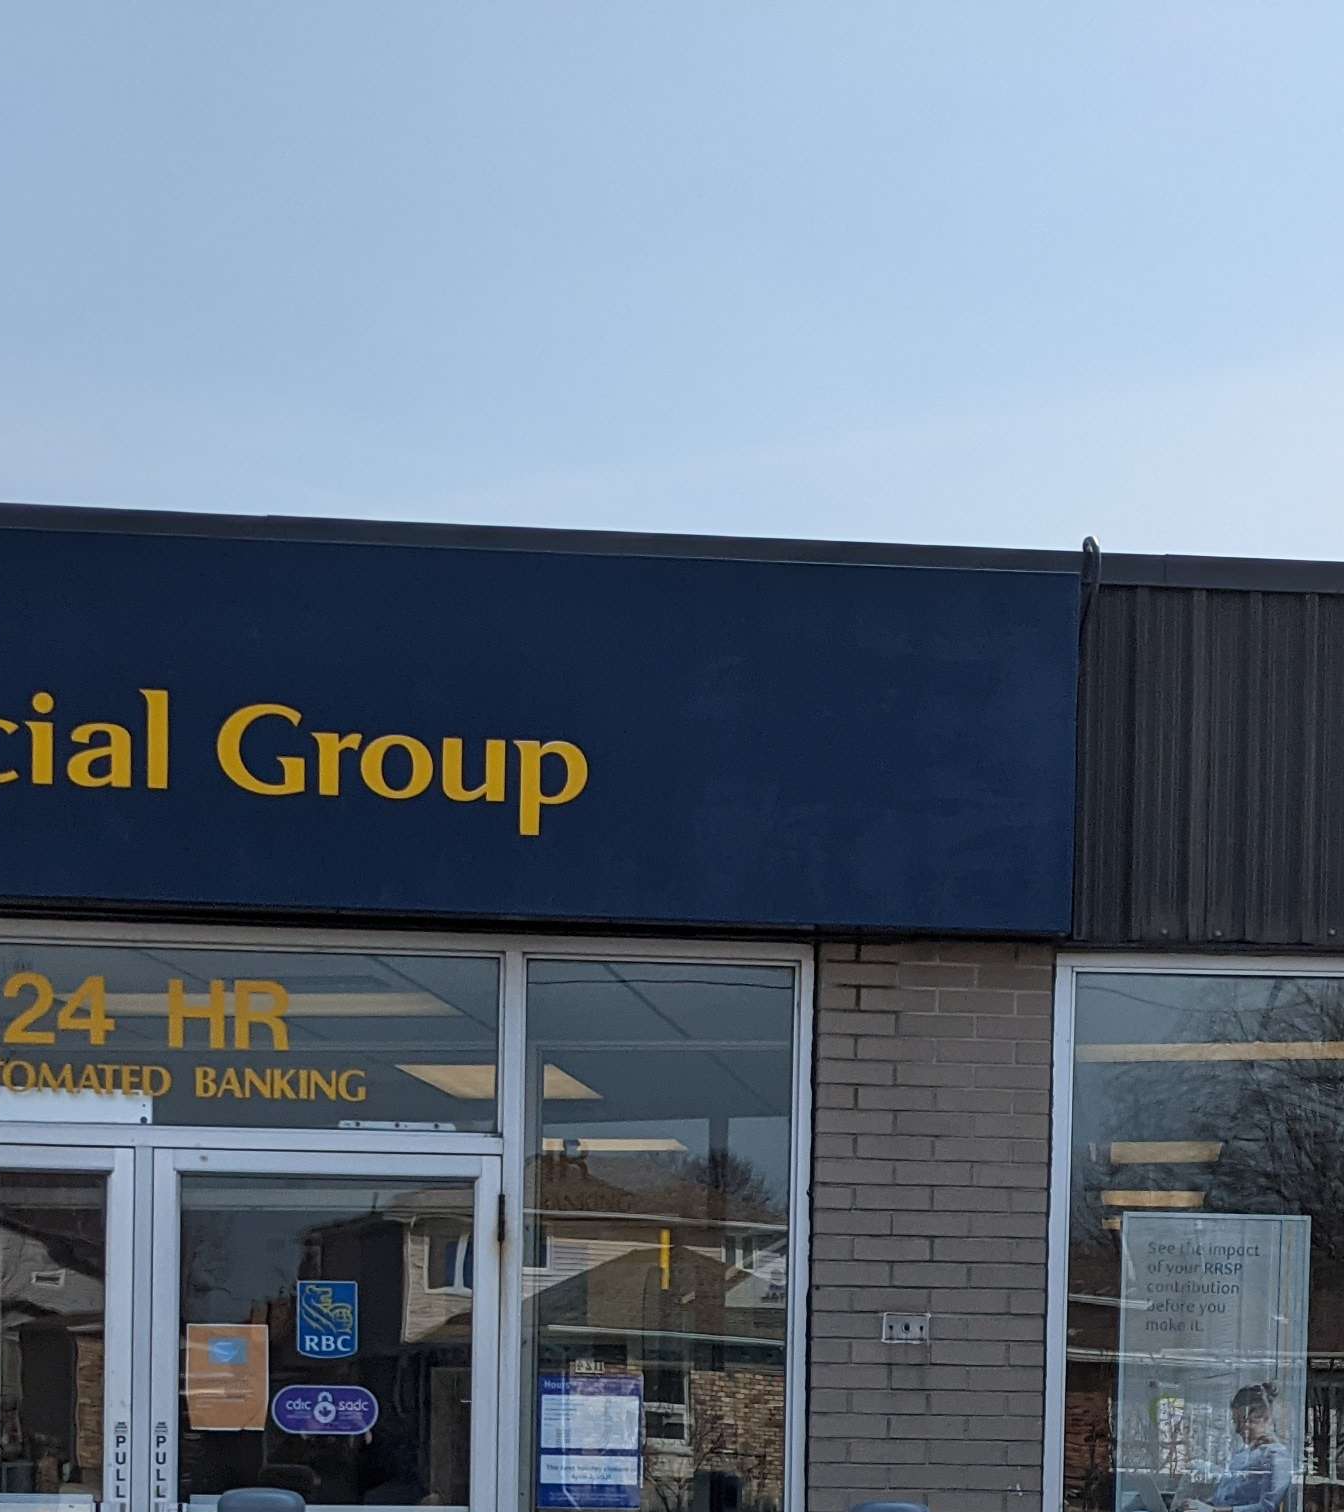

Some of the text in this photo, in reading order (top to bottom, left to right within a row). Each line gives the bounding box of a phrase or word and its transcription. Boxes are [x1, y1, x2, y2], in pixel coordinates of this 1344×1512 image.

[217, 703, 588, 836] Group
[2, 971, 290, 1052] 24 HR
[194, 1065, 367, 1102] BANKING
[1147, 1241, 1176, 1256] See
[1209, 1243, 1261, 1260] impact
[1147, 1260, 1244, 1277] of your RRSP
[1146, 1280, 1240, 1295] contribution
[1147, 1299, 1227, 1316] before you
[1145, 1318, 1186, 1332] make
[305, 1335, 352, 1351] RBC
[285, 1398, 369, 1411] cdic sadc
[115, 1435, 127, 1499] PULL
[156, 1435, 167, 1499] PULL
